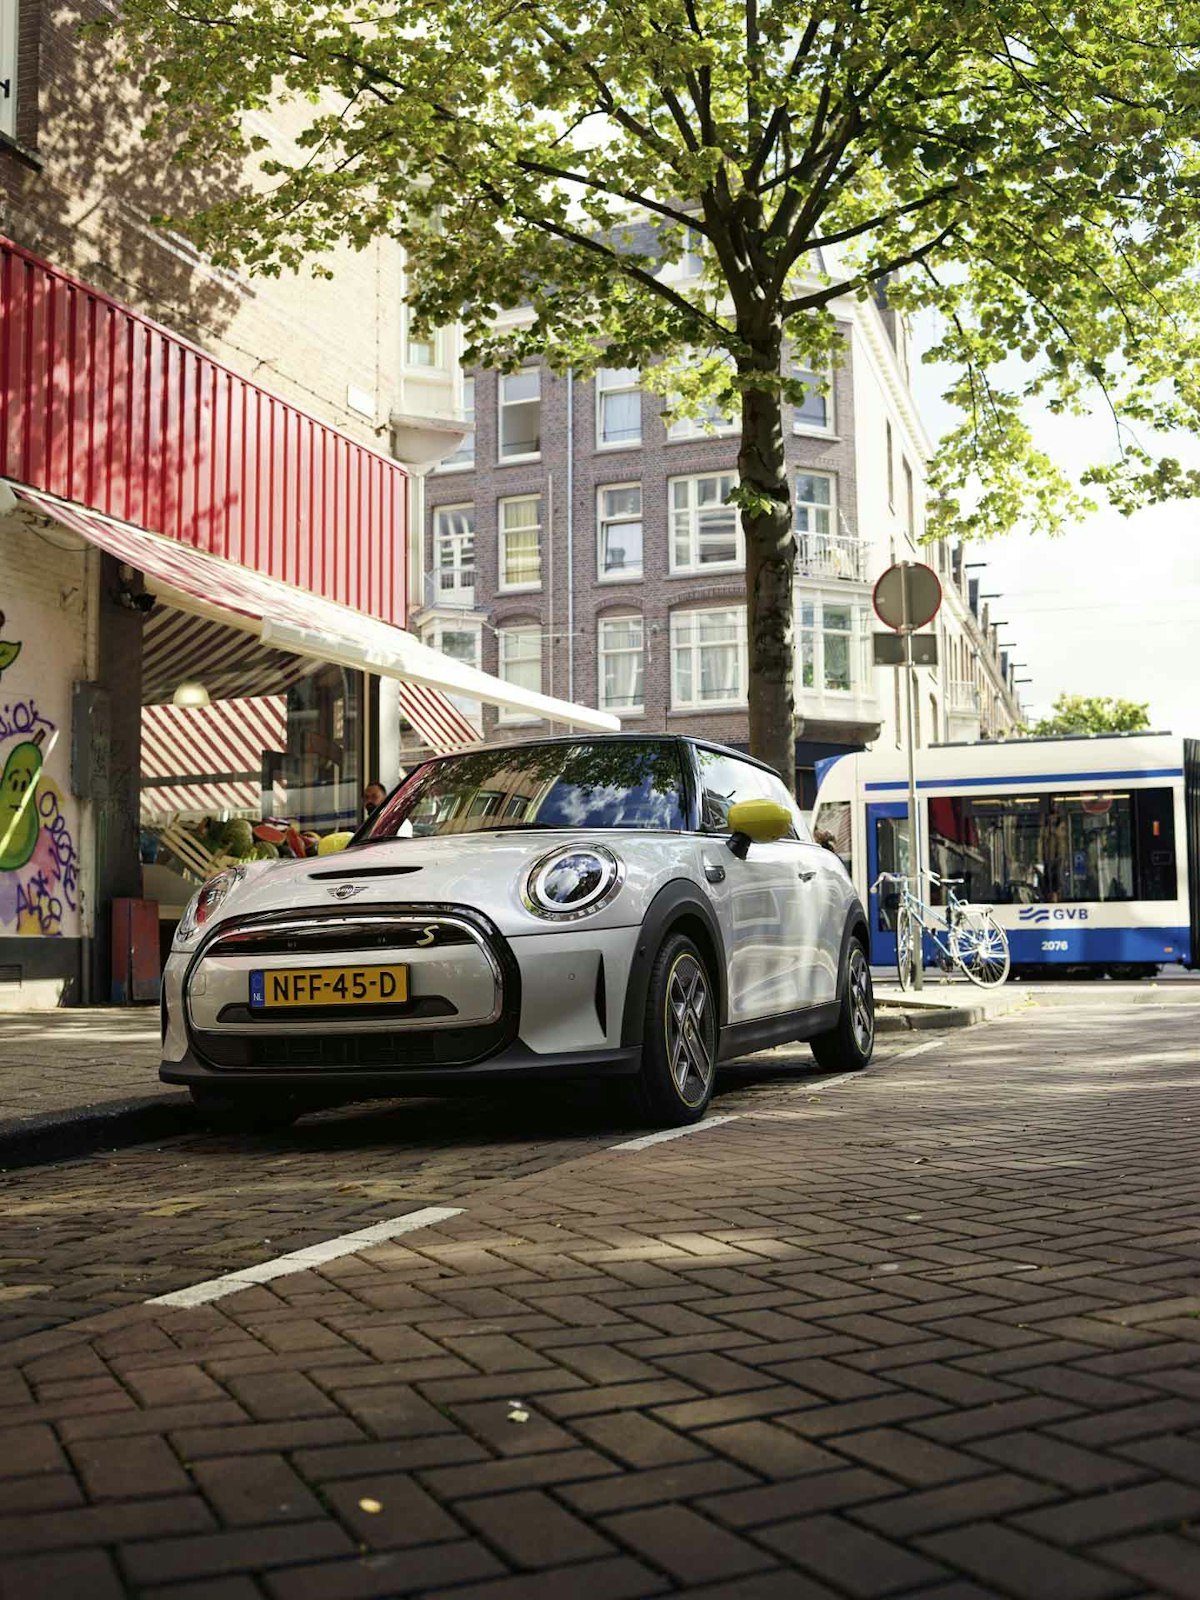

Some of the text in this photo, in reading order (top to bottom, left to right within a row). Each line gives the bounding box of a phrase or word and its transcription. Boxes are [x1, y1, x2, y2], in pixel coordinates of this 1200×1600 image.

[1053, 908, 1089, 920] GVB
[416, 924, 440, 947] S
[1041, 940, 1068, 951] 2076
[273, 971, 397, 1001] NFF-45-D
[253, 992, 263, 1001] NL
